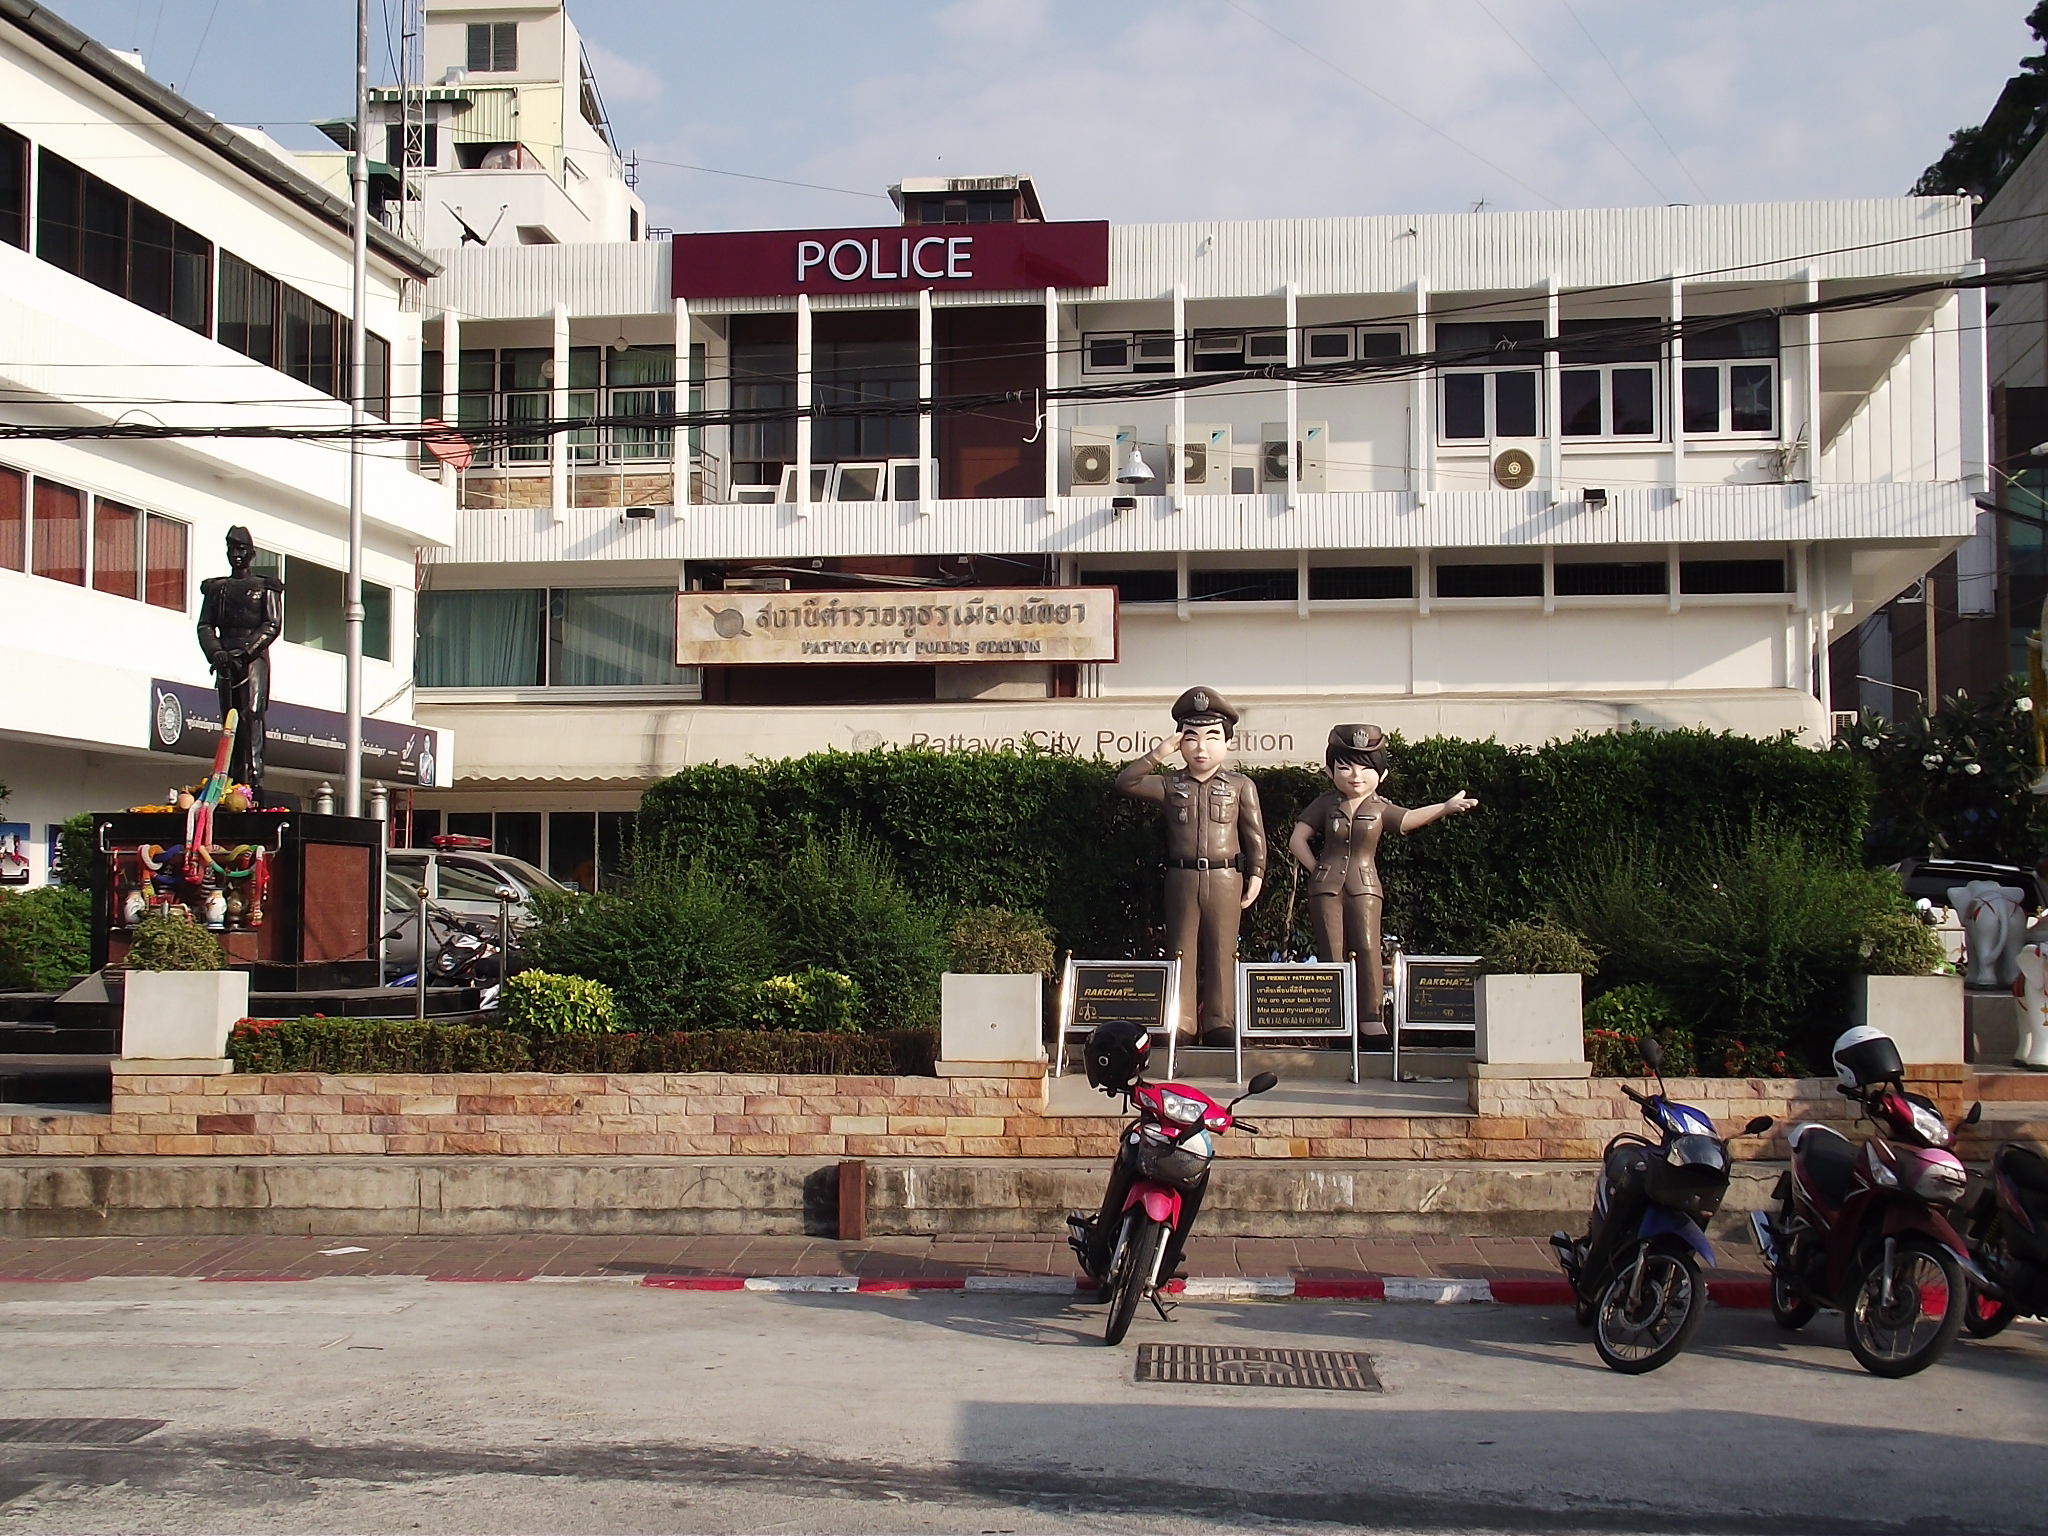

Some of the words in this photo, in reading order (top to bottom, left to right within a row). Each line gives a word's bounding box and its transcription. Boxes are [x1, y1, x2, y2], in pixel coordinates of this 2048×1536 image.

[797, 236, 973, 282] POLICE
[801, 640, 869, 655] PATTAYA
[870, 641, 911, 655] CITY
[915, 640, 970, 654] POLICE
[975, 639, 1041, 654] STATION
[1029, 730, 1082, 756] City
[1096, 730, 1163, 753] Polic
